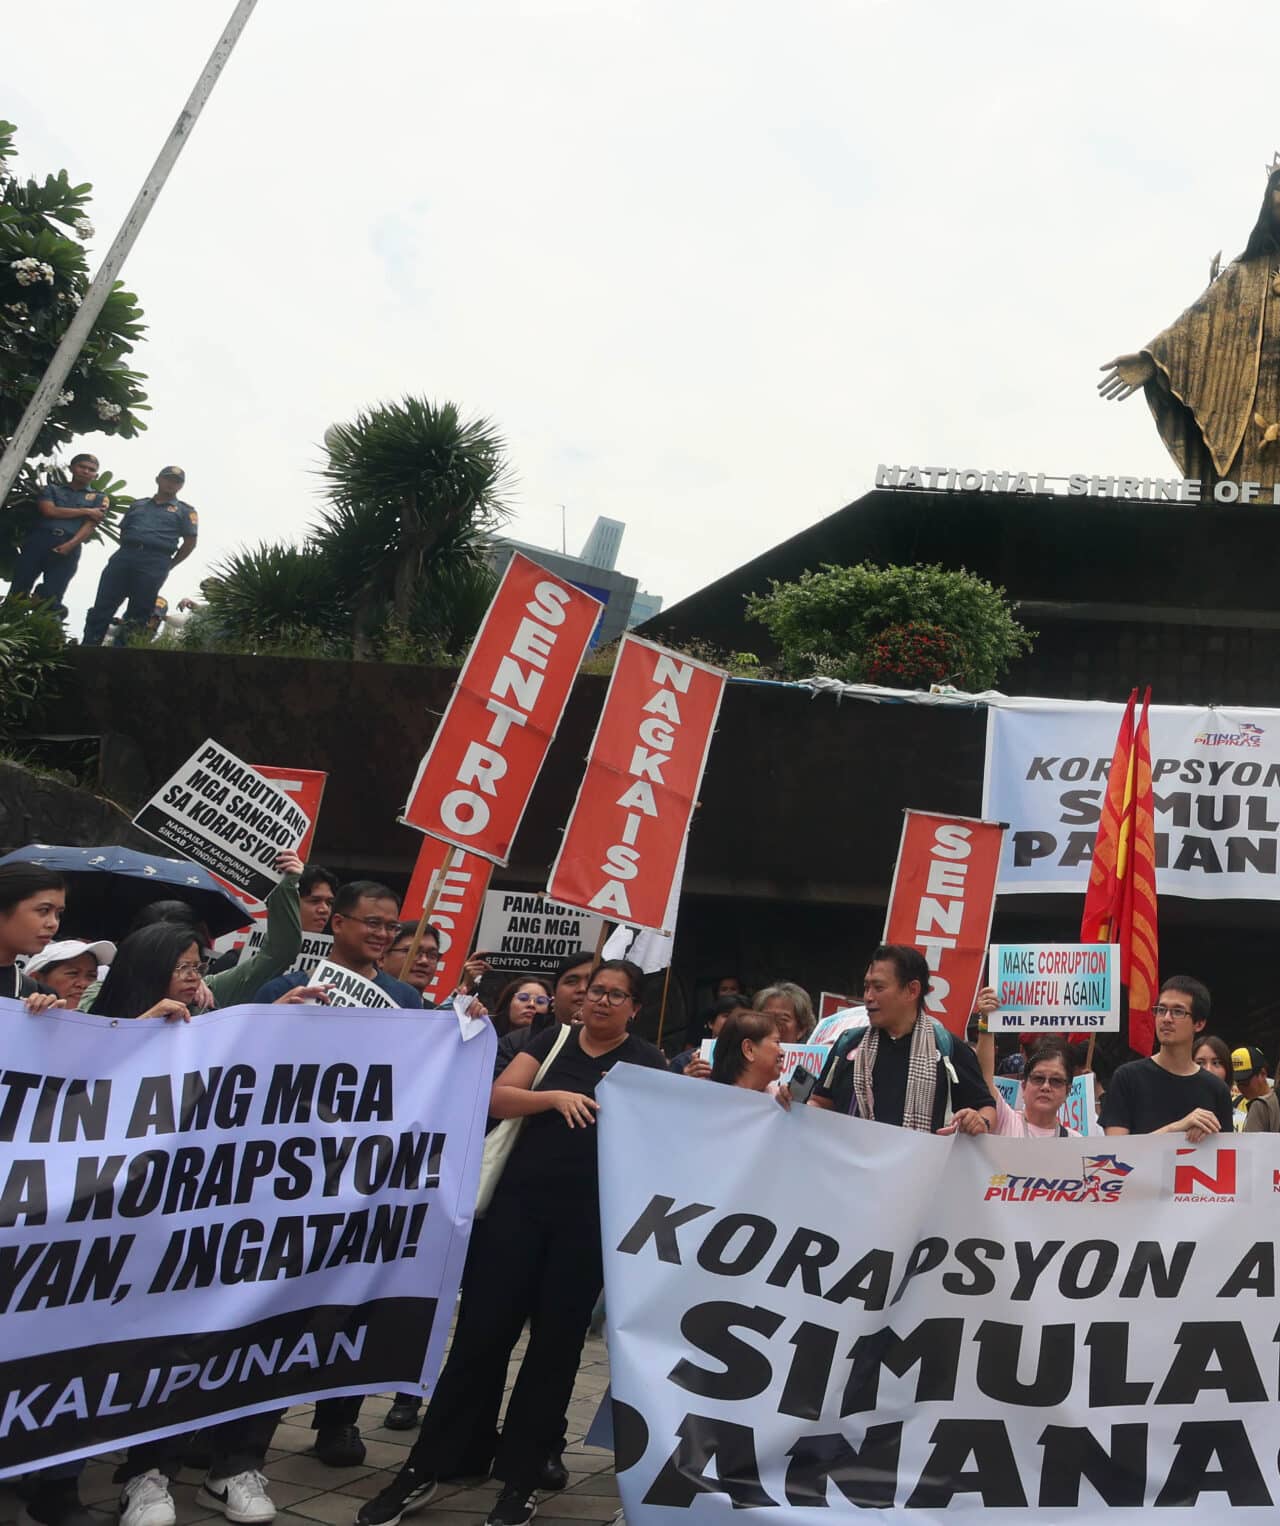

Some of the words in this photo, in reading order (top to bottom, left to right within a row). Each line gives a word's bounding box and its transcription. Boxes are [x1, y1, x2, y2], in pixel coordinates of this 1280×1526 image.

[875, 464, 1054, 495] NATIONAL
[1067, 474, 1201, 501] SHRINE
[1214, 480, 1259, 503] OF
[440, 581, 571, 835] SENTRO
[163, 785, 192, 812] SA
[186, 769, 230, 806] MGA
[226, 796, 296, 849] SANGKOT
[198, 746, 286, 817] PANAGUTIN
[282, 809, 306, 836] ANG
[587, 654, 694, 918] NAGKAISA
[486, 957, 529, 967] SENTRO
[507, 917, 541, 933] ANG
[544, 919, 580, 936] MGA
[912, 825, 973, 1028] SENTR
[1003, 952, 1034, 973] MAKE
[1038, 952, 1106, 973] CORRUPTION
[1001, 982, 1059, 1006] SHAMEFUL
[1064, 978, 1106, 1008] AGAIN!
[1003, 1016, 1025, 1026] ML
[1030, 1016, 1106, 1026] PARTYLIST
[0, 1069, 112, 1143] TIN
[126, 1065, 258, 1140] ANG
[262, 1064, 393, 1129] MGA
[66, 1132, 446, 1224] KORAPSYON!
[147, 1203, 429, 1294] INGATAN!
[617, 1194, 1196, 1311] KORAPSYON
[2, 1325, 368, 1438] KALIPUNAN
